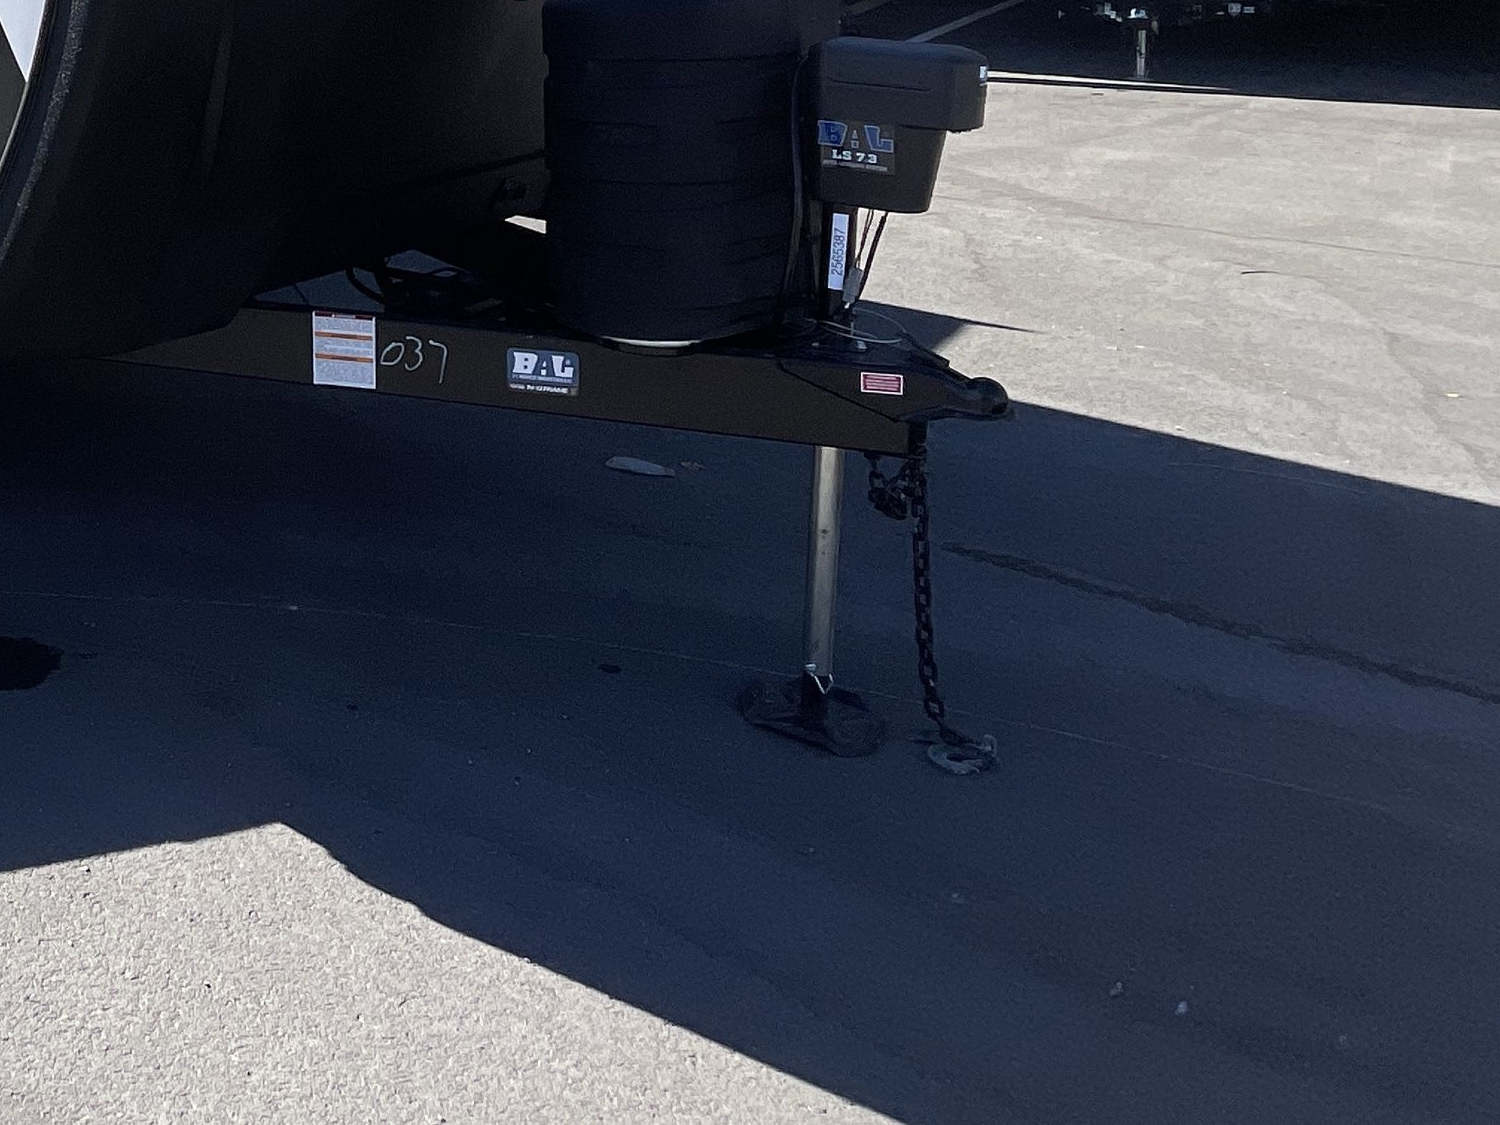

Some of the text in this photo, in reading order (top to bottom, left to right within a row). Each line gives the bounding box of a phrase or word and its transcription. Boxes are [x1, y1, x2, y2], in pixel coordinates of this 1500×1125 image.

[818, 120, 894, 153] BAL
[832, 149, 852, 161] LS
[380, 336, 448, 384] 037
[512, 351, 574, 378] BAL
